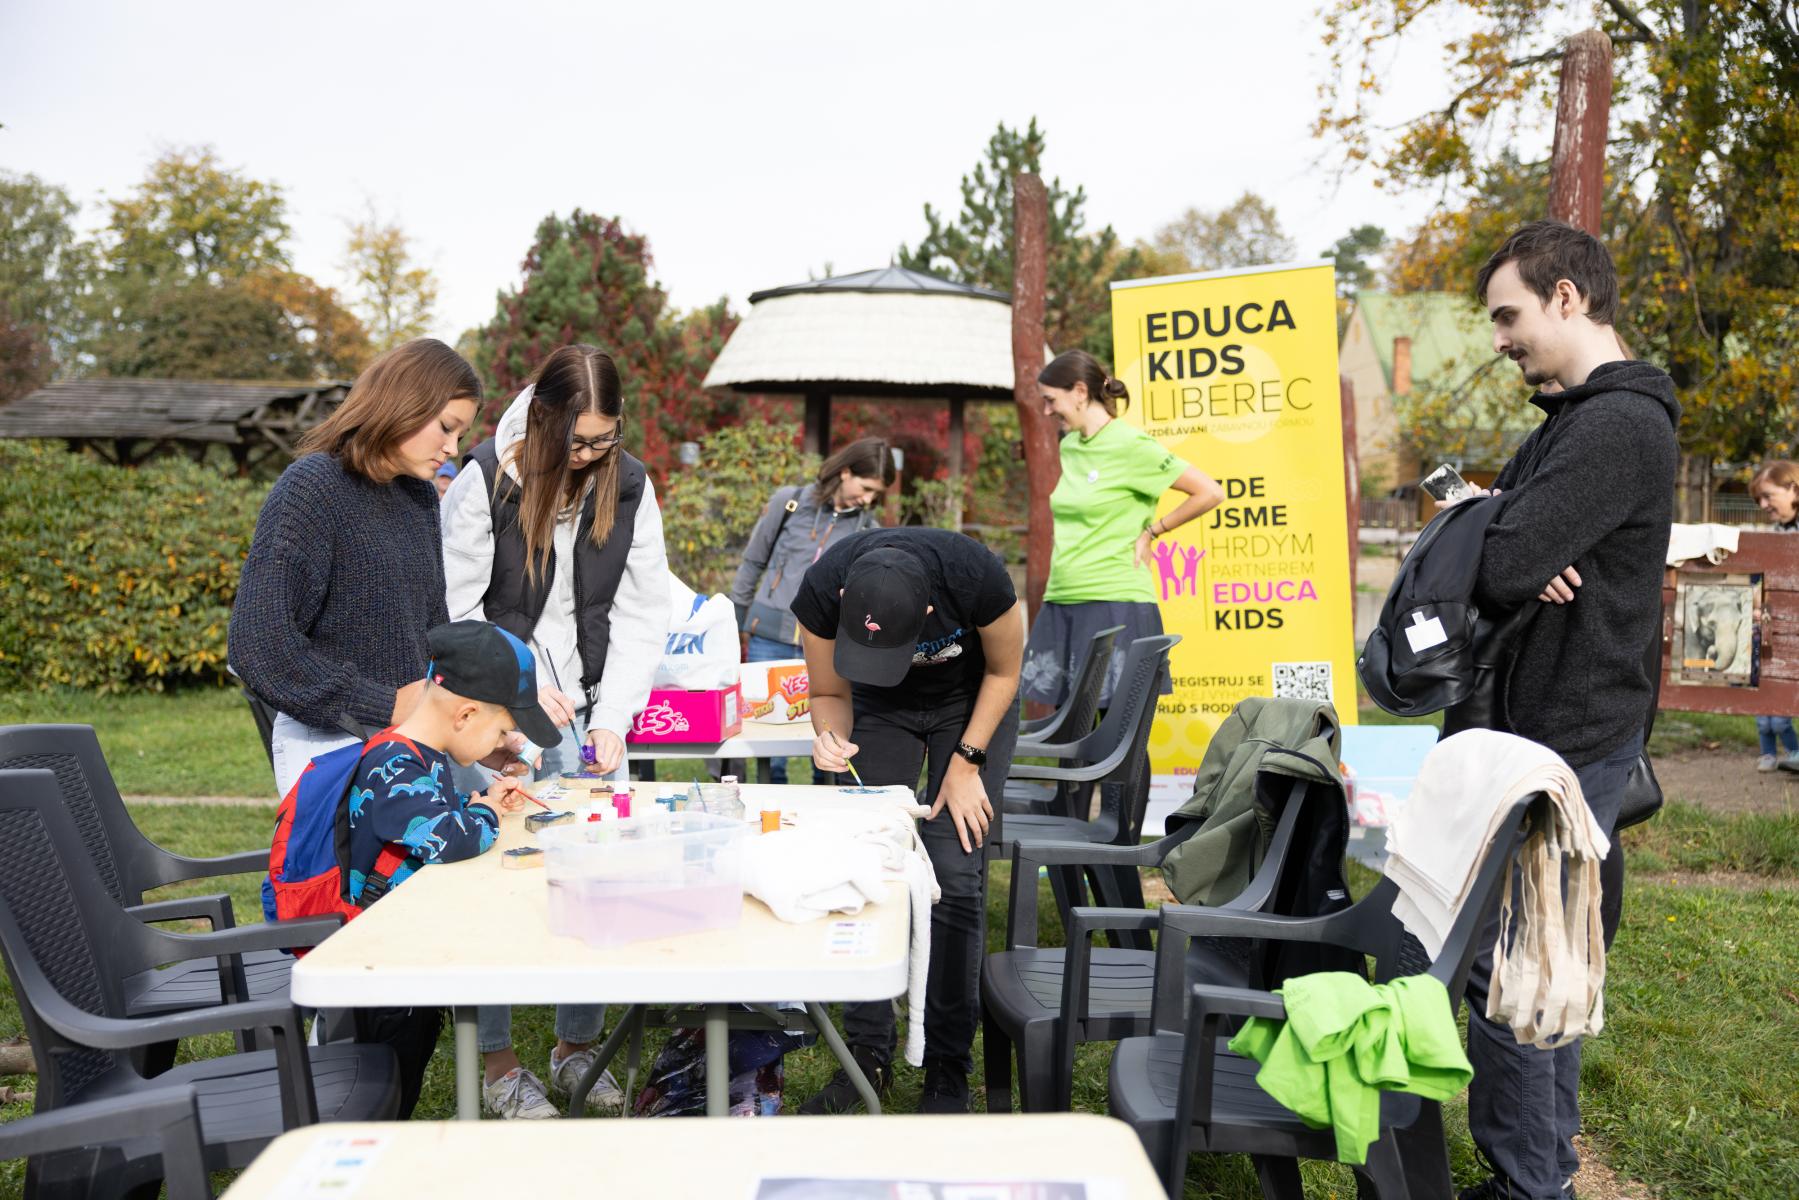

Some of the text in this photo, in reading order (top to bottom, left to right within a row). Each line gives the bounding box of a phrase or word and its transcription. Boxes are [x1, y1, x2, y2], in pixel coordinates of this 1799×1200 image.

[1146, 299, 1296, 343] EDUCA
[1148, 344, 1245, 382] KIDS
[1150, 377, 1313, 421] LIBEREC
[1215, 477, 1265, 499] DE
[1210, 505, 1287, 529] JSME
[1210, 528, 1314, 559] HRDÝM
[1211, 561, 1315, 579] PARTNEREM
[1213, 579, 1318, 604] EDUCA
[1215, 608, 1284, 630] KIDS
[1171, 675, 1264, 687] REGISTRUJ SE
[1190, 703, 1198, 714] S
